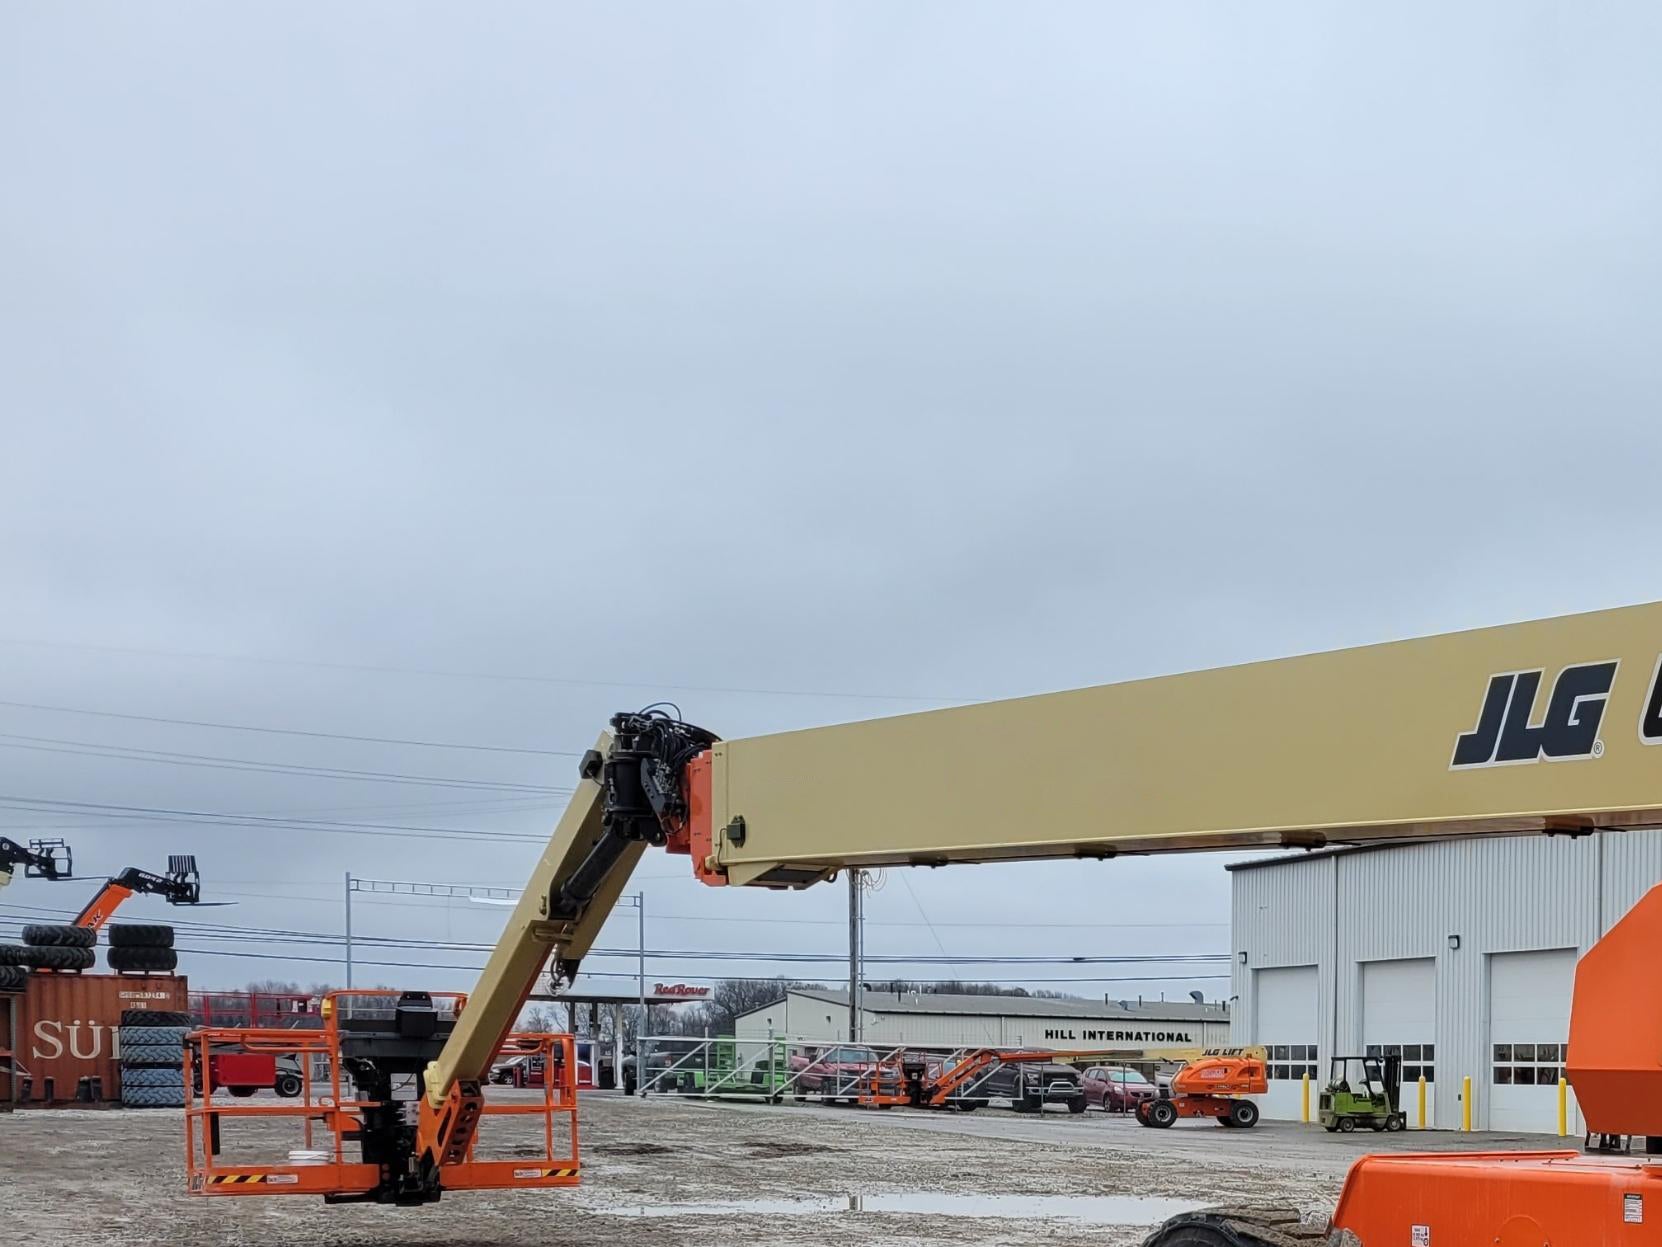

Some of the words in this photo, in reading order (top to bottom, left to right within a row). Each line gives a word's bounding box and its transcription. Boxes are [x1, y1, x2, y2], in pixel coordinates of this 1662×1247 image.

[1450, 660, 1619, 768] JLG
[1045, 1030, 1076, 1040] HILL
[1083, 1030, 1192, 1042] INTERNATIONAL
[1202, 1048, 1220, 1056] JLG
[1222, 1048, 1244, 1056] LIFT
